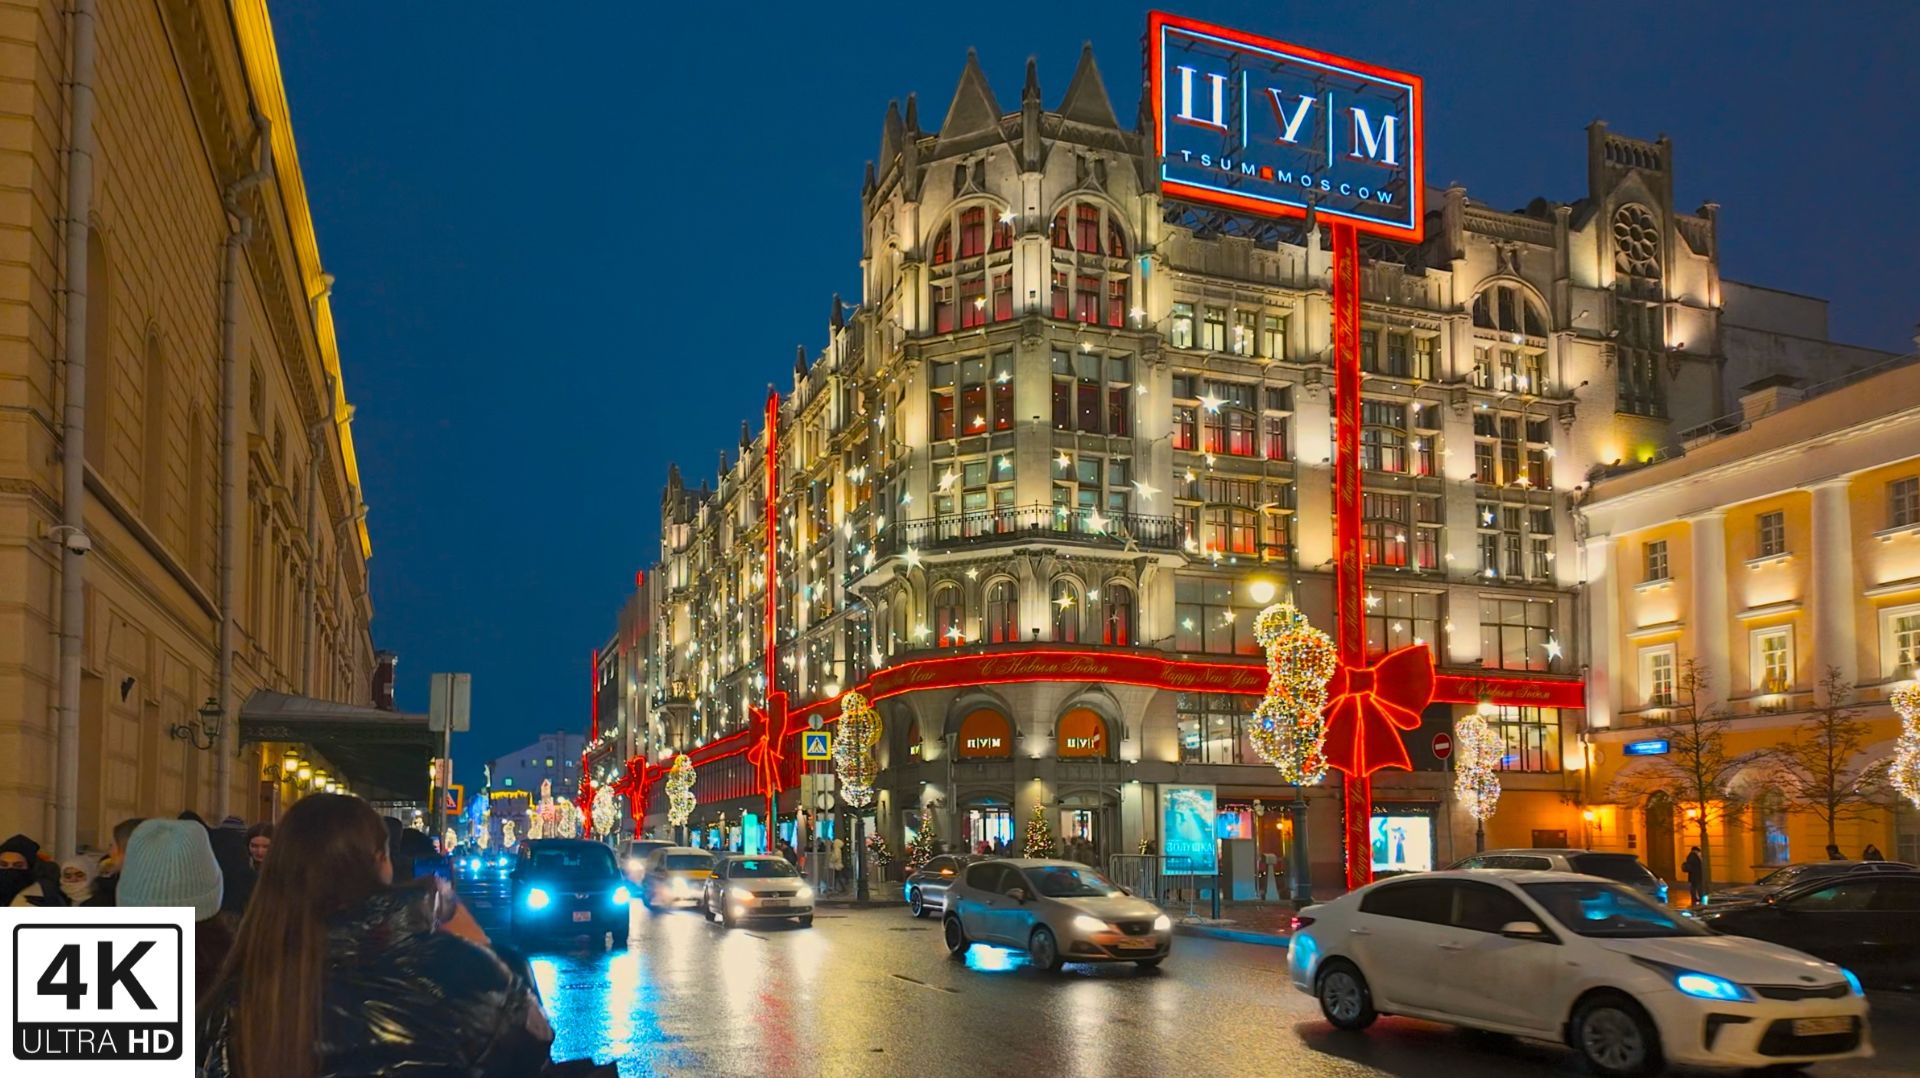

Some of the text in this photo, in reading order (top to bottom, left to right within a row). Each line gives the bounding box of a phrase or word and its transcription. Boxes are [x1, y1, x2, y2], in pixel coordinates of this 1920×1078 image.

[1277, 169, 1394, 205] MOSCOW
[996, 654, 1058, 675] Новым
[1160, 664, 1197, 686] Happy
[1228, 669, 1260, 688] Year
